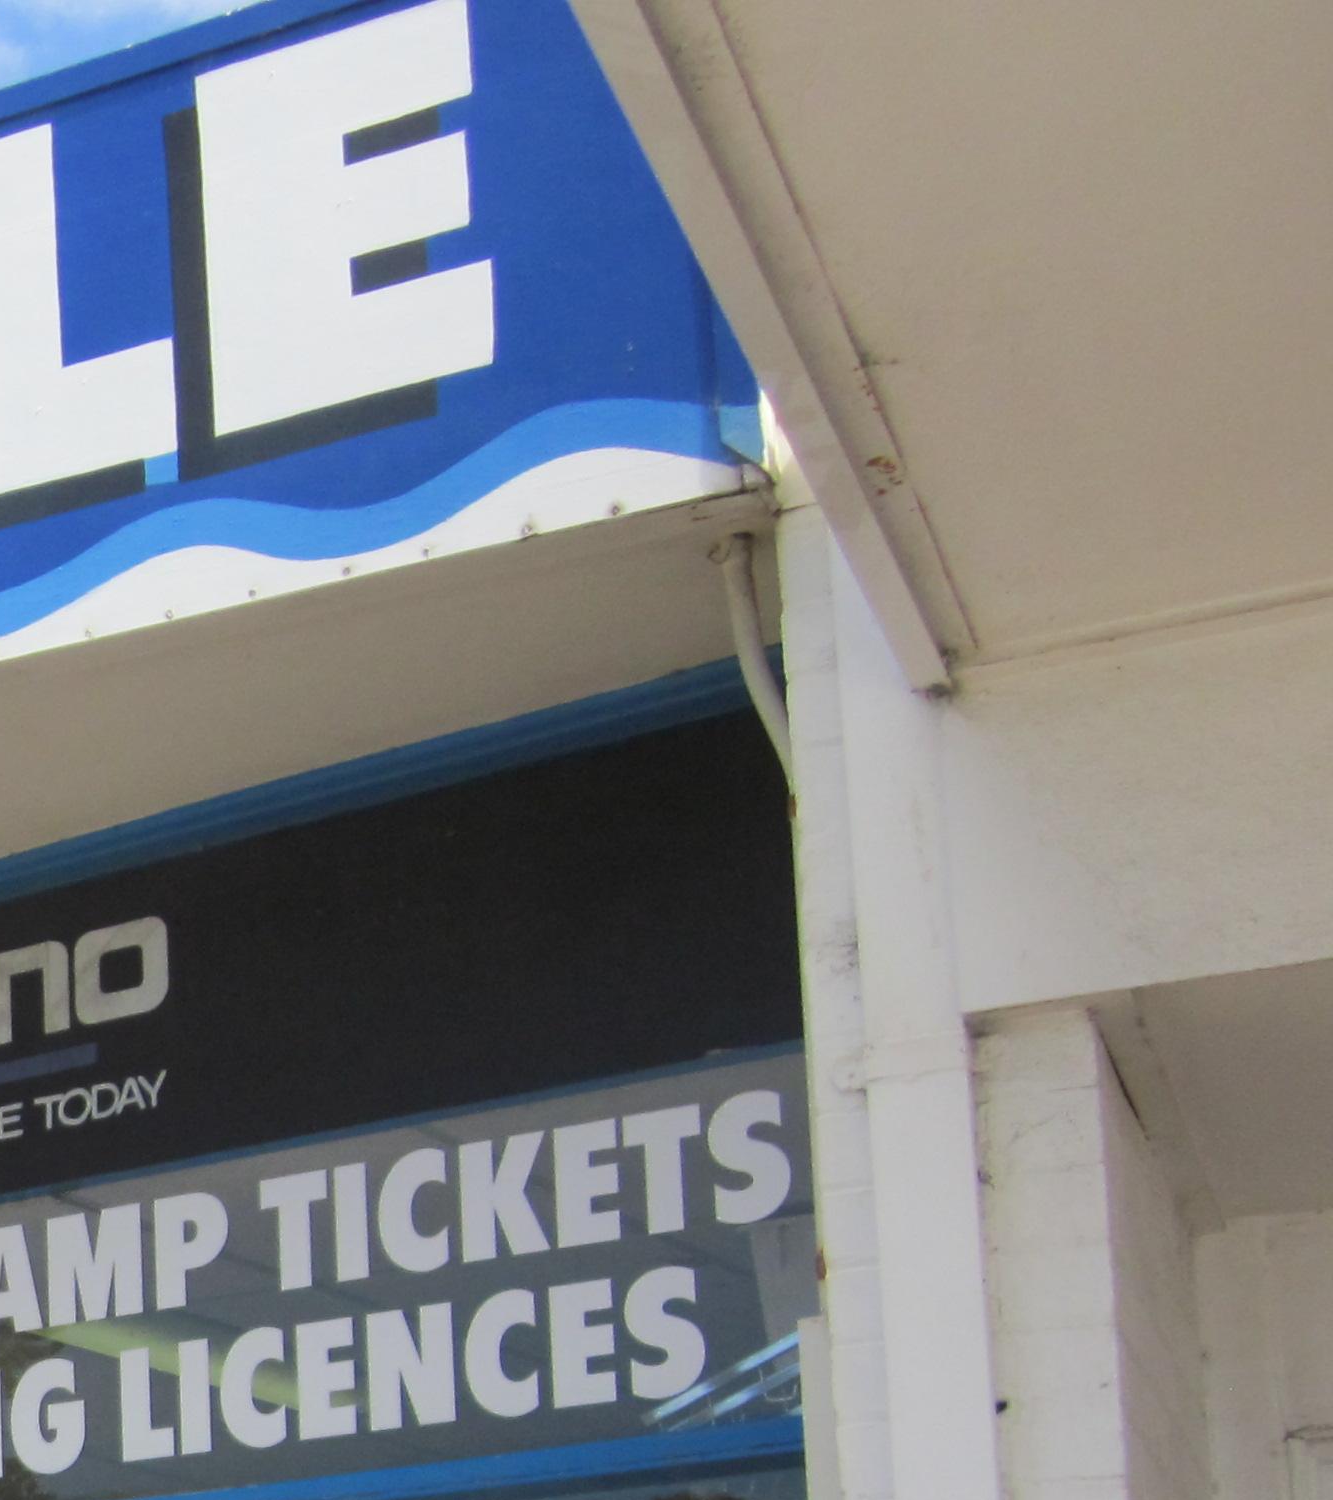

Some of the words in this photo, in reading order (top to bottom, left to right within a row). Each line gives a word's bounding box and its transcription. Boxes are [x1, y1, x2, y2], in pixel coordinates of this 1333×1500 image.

[34, 1069, 167, 1130] TODAY
[261, 1089, 792, 1290] TICKETS
[119, 1265, 707, 1462] LICENCES
